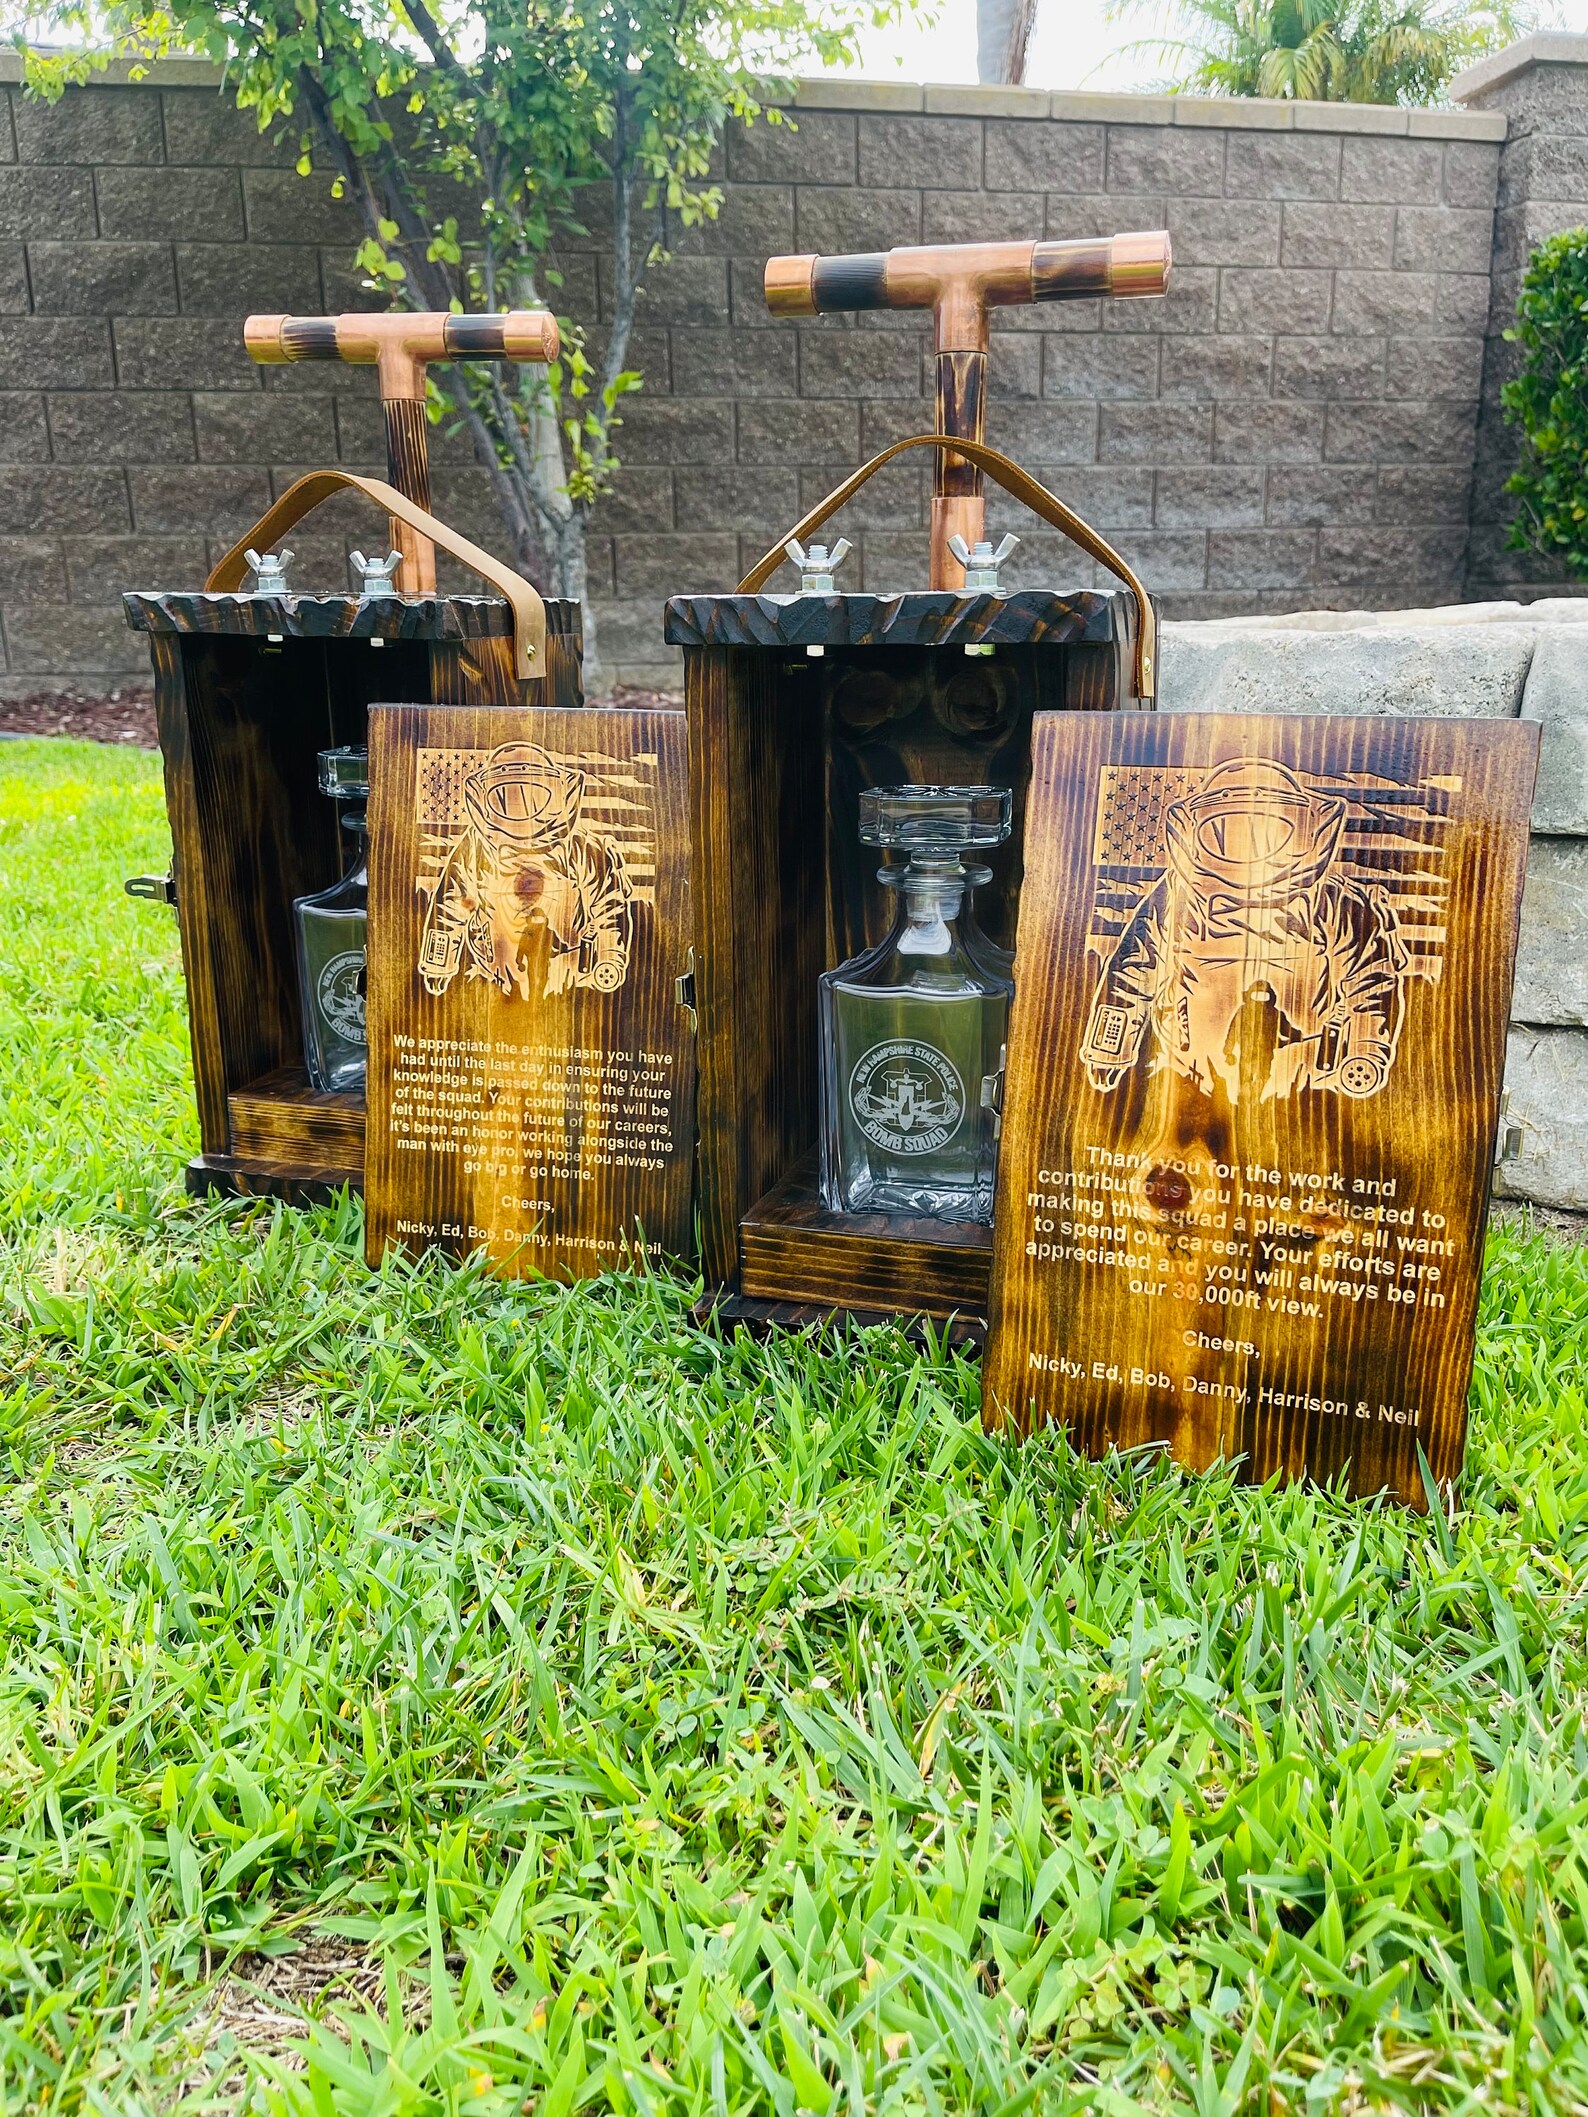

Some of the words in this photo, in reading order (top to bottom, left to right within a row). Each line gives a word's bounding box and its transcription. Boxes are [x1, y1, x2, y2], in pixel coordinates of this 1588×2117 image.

[393, 1034, 415, 1048] We
[418, 1038, 491, 1055] appreciate
[495, 1041, 517, 1054] the
[522, 1043, 602, 1060] enthusiasm
[608, 1050, 633, 1064] you
[638, 1050, 672, 1065] have
[400, 1053, 425, 1065] had
[430, 1055, 461, 1068] until
[465, 1057, 485, 1069] the
[490, 1059, 515, 1072] last
[519, 1060, 544, 1075] day
[549, 1060, 561, 1074] in
[566, 1062, 628, 1082] ensuring
[633, 1069, 665, 1082] your
[855, 1062, 871, 1083] NEW
[866, 1045, 914, 1066] HAMPSHIRE
[915, 1047, 940, 1066] STATE
[936, 1061, 958, 1091] POLICE
[393, 1070, 468, 1086] knowledge
[472, 1074, 484, 1086] is
[488, 1075, 537, 1090] passed
[542, 1078, 580, 1093] down
[585, 1081, 599, 1094] to
[603, 1082, 625, 1097] the
[629, 1085, 671, 1100] future
[396, 1087, 409, 1099] of
[413, 1087, 434, 1100] the
[438, 1090, 485, 1107] squad.
[489, 1092, 522, 1106] Your
[525, 1094, 618, 1114] contributions
[622, 1100, 647, 1115] will
[652, 1103, 669, 1117] be
[391, 1104, 413, 1115] felt
[416, 1105, 493, 1122] throughout
[497, 1109, 519, 1123] the
[523, 1111, 565, 1126] future
[569, 1113, 583, 1128] of
[587, 1117, 611, 1130] our
[615, 1119, 672, 1136] careers,
[414, 1121, 447, 1135] been
[451, 1124, 468, 1136] an
[472, 1125, 513, 1140] honor
[517, 1129, 574, 1146] working
[578, 1133, 646, 1152] alongside
[651, 1137, 673, 1152] the
[864, 1121, 903, 1149] BOMB
[904, 1127, 949, 1152] SQUAD
[397, 1139, 426, 1150] man
[431, 1139, 459, 1152] with
[463, 1143, 488, 1157] eye
[523, 1148, 542, 1159] we
[547, 1148, 581, 1164] hope
[585, 1153, 611, 1166] you
[616, 1153, 664, 1169] always
[464, 1159, 481, 1173] go
[485, 1160, 507, 1175] big
[511, 1162, 526, 1174] or
[529, 1163, 548, 1178] go
[551, 1164, 595, 1181] home.
[1086, 1146, 1152, 1170] Thank
[1158, 1157, 1201, 1178] you
[1208, 1158, 1239, 1179] for
[1246, 1163, 1282, 1185] the
[1289, 1170, 1346, 1192] work
[1352, 1175, 1396, 1197] and
[501, 1195, 555, 1213] Cheers,
[1038, 1167, 1182, 1199] contributions
[1189, 1182, 1231, 1204] you
[1238, 1187, 1292, 1211] have
[1299, 1193, 1416, 1223] dedicated
[1421, 1207, 1446, 1229] to
[397, 1220, 438, 1236] Nicky,
[441, 1224, 464, 1239] Ed,
[468, 1225, 500, 1241] Bob,
[504, 1230, 551, 1246] Danny,
[555, 1233, 614, 1251] Harrison
[619, 1240, 629, 1252] &
[634, 1241, 662, 1255] Neil
[1027, 1190, 1105, 1218] making
[1111, 1197, 1153, 1218] this
[1157, 1204, 1227, 1229] squad
[1233, 1216, 1246, 1232] a
[1253, 1214, 1317, 1240] place
[1322, 1225, 1355, 1244] we
[1361, 1225, 1390, 1249] all
[1396, 1232, 1455, 1257] want
[1034, 1213, 1055, 1233] to
[1060, 1215, 1128, 1243] spend
[1133, 1225, 1170, 1246] our
[1175, 1231, 1252, 1257] career.
[1260, 1237, 1314, 1263] Your
[1318, 1248, 1396, 1276] efforts
[1403, 1258, 1441, 1281] are
[1025, 1236, 1151, 1271] appreciated
[1157, 1254, 1199, 1275] and
[1205, 1260, 1247, 1286] you
[1254, 1265, 1292, 1288] will
[1299, 1271, 1378, 1300] always
[1387, 1281, 1417, 1304] be
[1423, 1286, 1445, 1308] in
[1130, 1275, 1167, 1295] our
[1173, 1278, 1262, 1308] 30,000ft
[1268, 1294, 1324, 1318] view.
[1182, 1329, 1261, 1358] Cheers,
[1028, 1352, 1086, 1379] Nicky,
[1092, 1361, 1123, 1382] Ed,
[1130, 1366, 1176, 1392] Bob,
[1182, 1374, 1252, 1404] Danny,
[1258, 1386, 1348, 1416] Harrison
[1355, 1400, 1371, 1418] &
[1378, 1404, 1420, 1427] Neil
